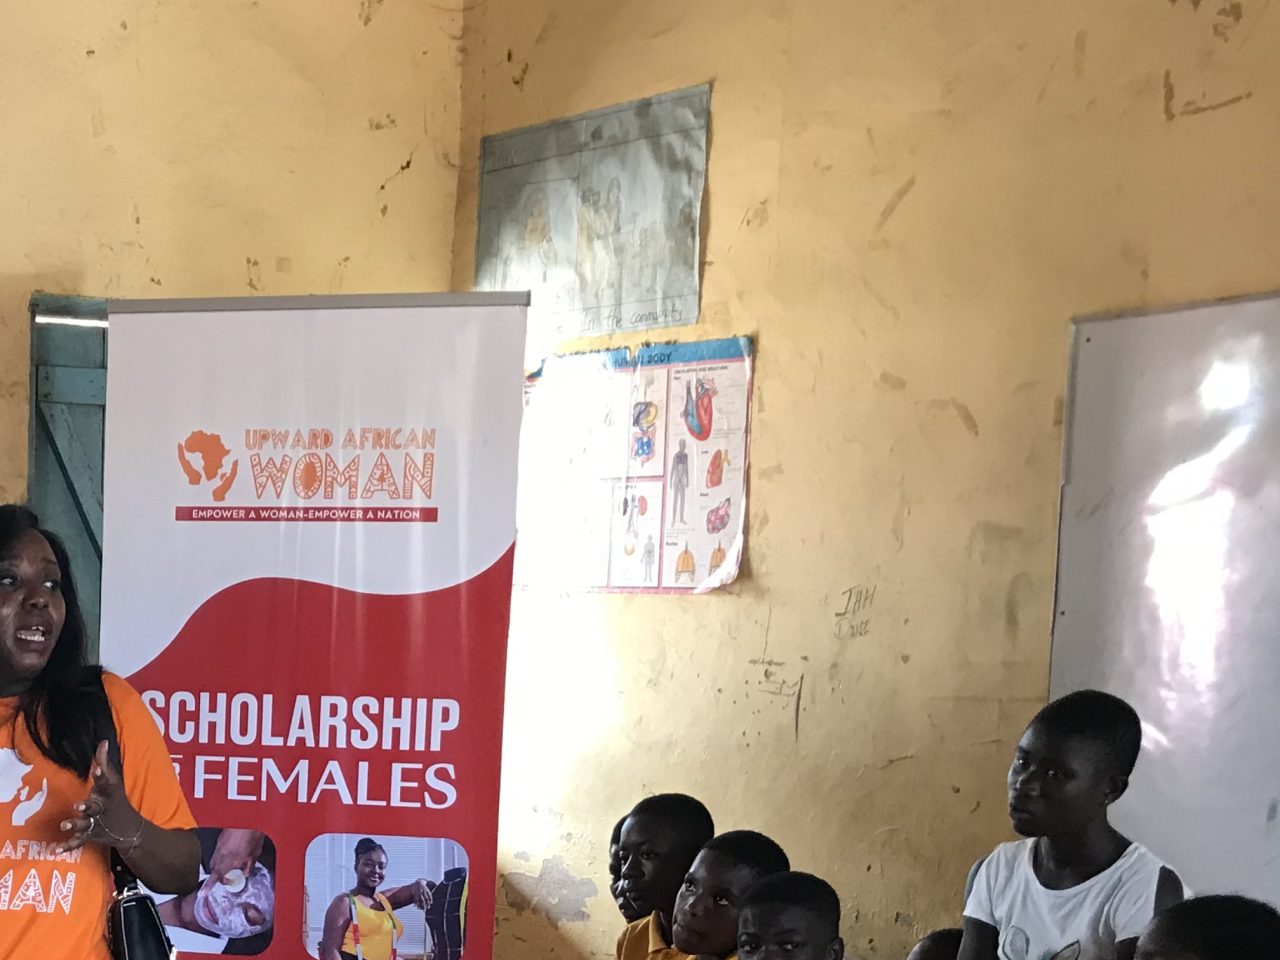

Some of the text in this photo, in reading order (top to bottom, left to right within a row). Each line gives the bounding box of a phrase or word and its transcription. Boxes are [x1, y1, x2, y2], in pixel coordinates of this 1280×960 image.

[604, 307, 623, 328] the
[648, 352, 673, 364] BODY
[245, 428, 436, 450] UPWARD AFRICAN
[250, 452, 435, 500] WOMAN
[192, 509, 246, 520] EMPOWER
[249, 510, 256, 520] A
[366, 510, 374, 520] A
[377, 510, 420, 520] NATION
[141, 690, 460, 752] SCHOLARSHIP
[194, 755, 458, 810] FEMALES
